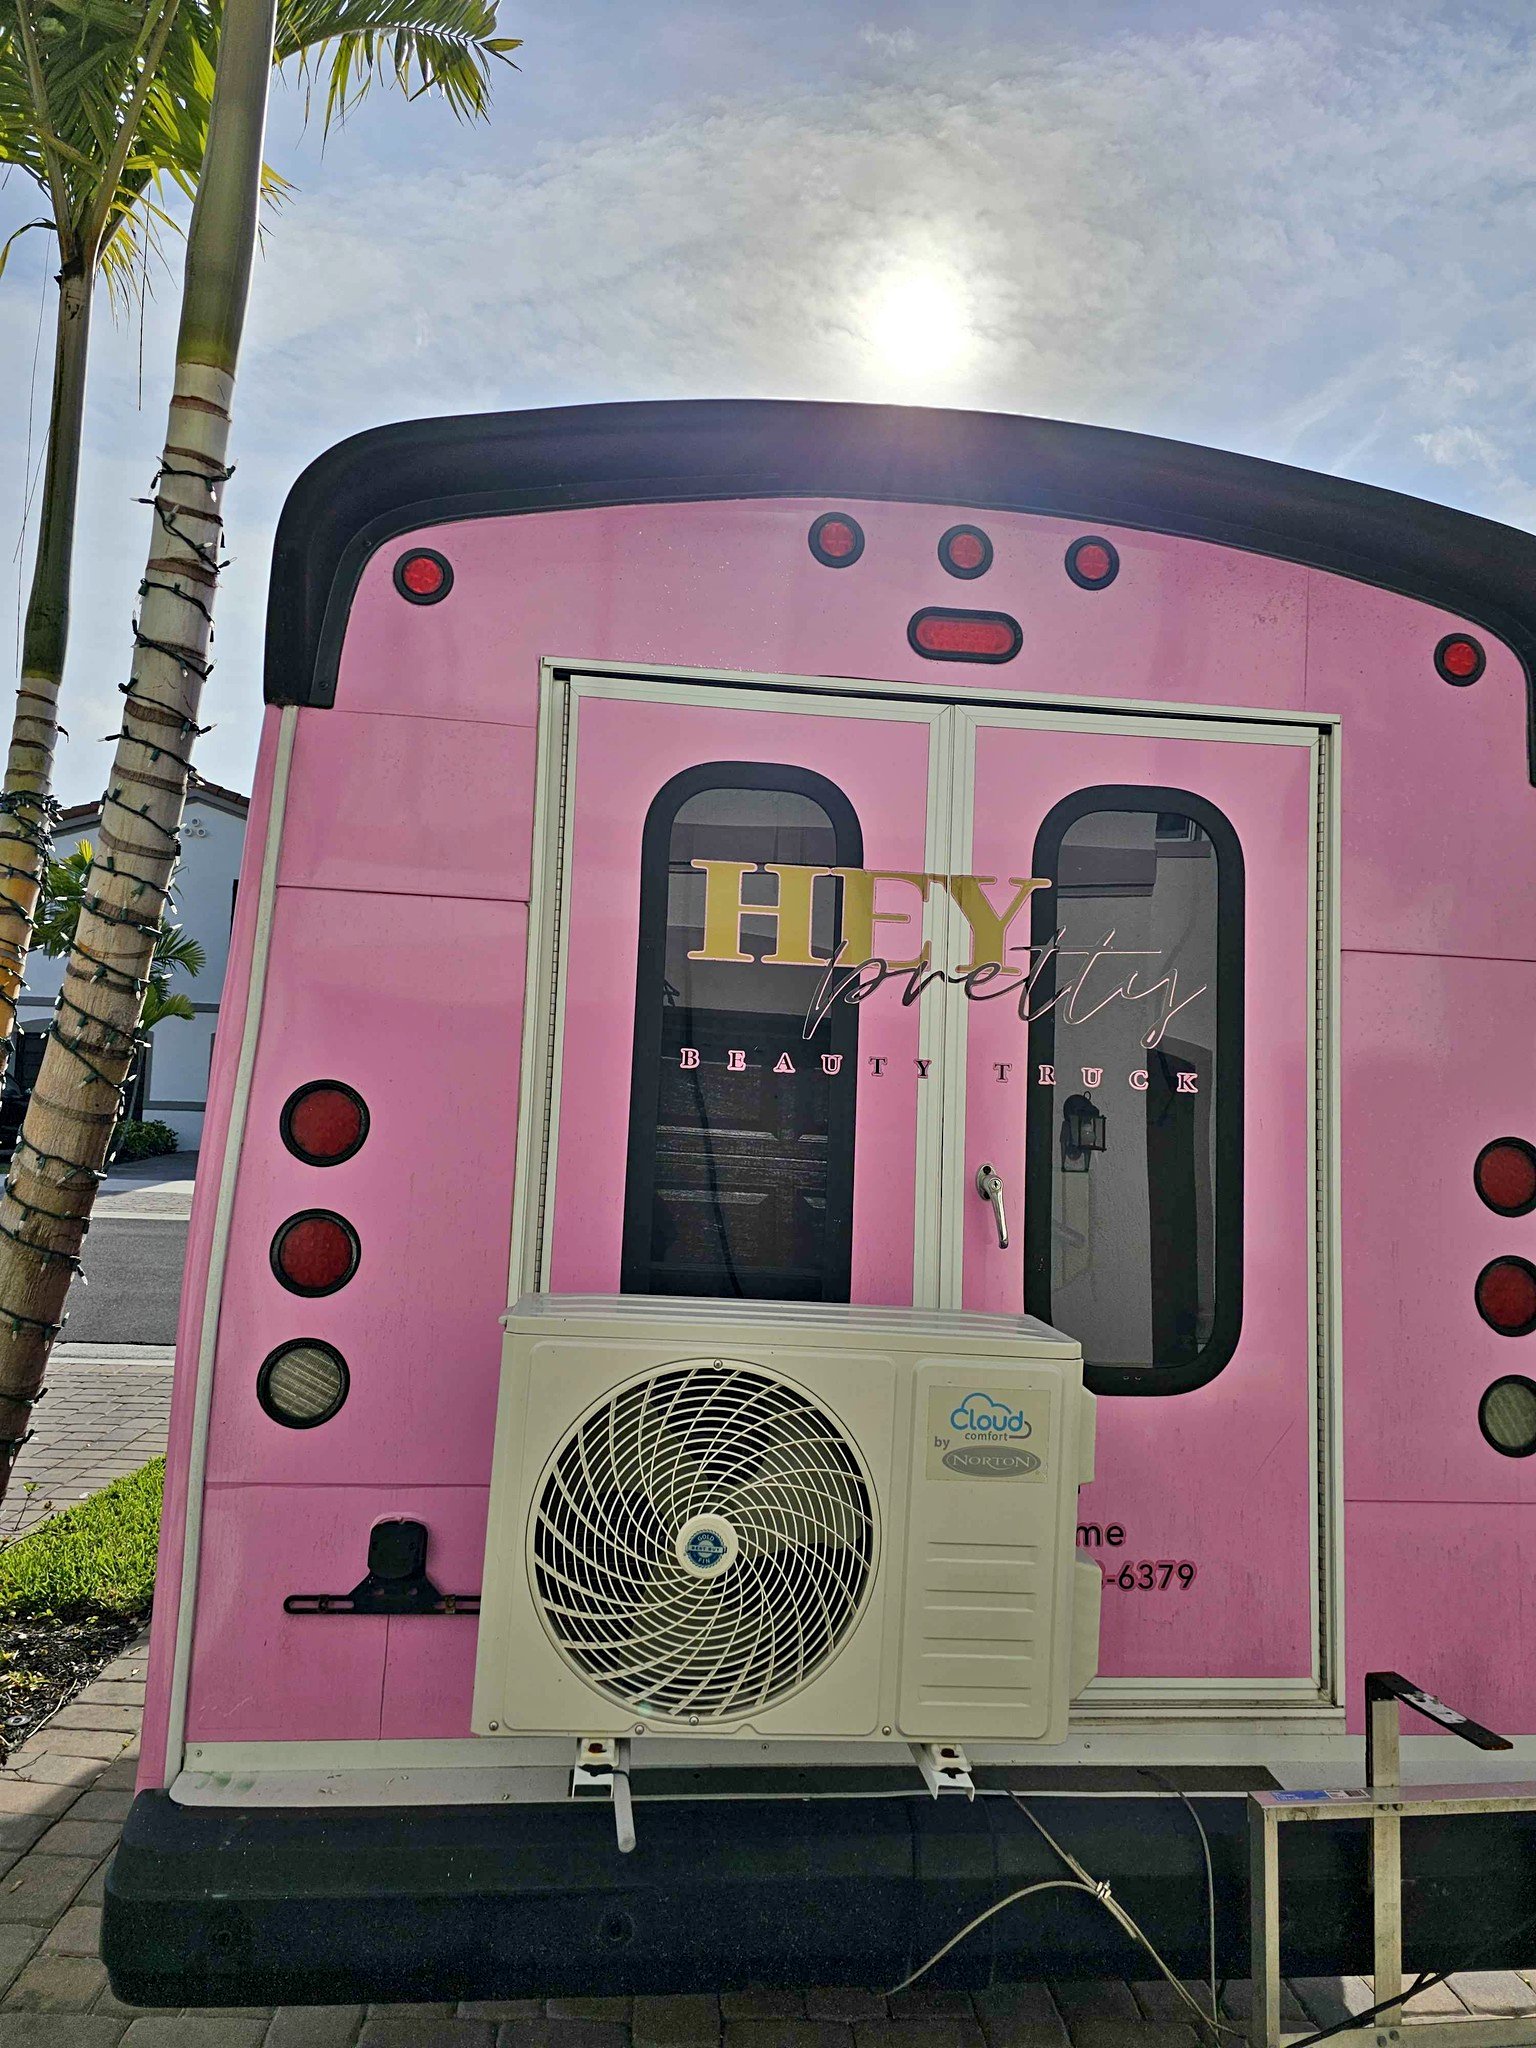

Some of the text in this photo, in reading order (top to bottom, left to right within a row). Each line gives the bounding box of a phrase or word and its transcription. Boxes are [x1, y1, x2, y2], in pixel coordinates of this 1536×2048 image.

[687, 859, 1052, 976] HEY
[802, 925, 1208, 1050] pretty
[679, 1047, 1200, 1094] BEAUTY TRUCK
[950, 1408, 1024, 1432] Cloud
[965, 1431, 1008, 1441] comfort
[934, 1436, 1030, 1470] by NORTON
[1101, 1562, 1196, 1591] -6379
